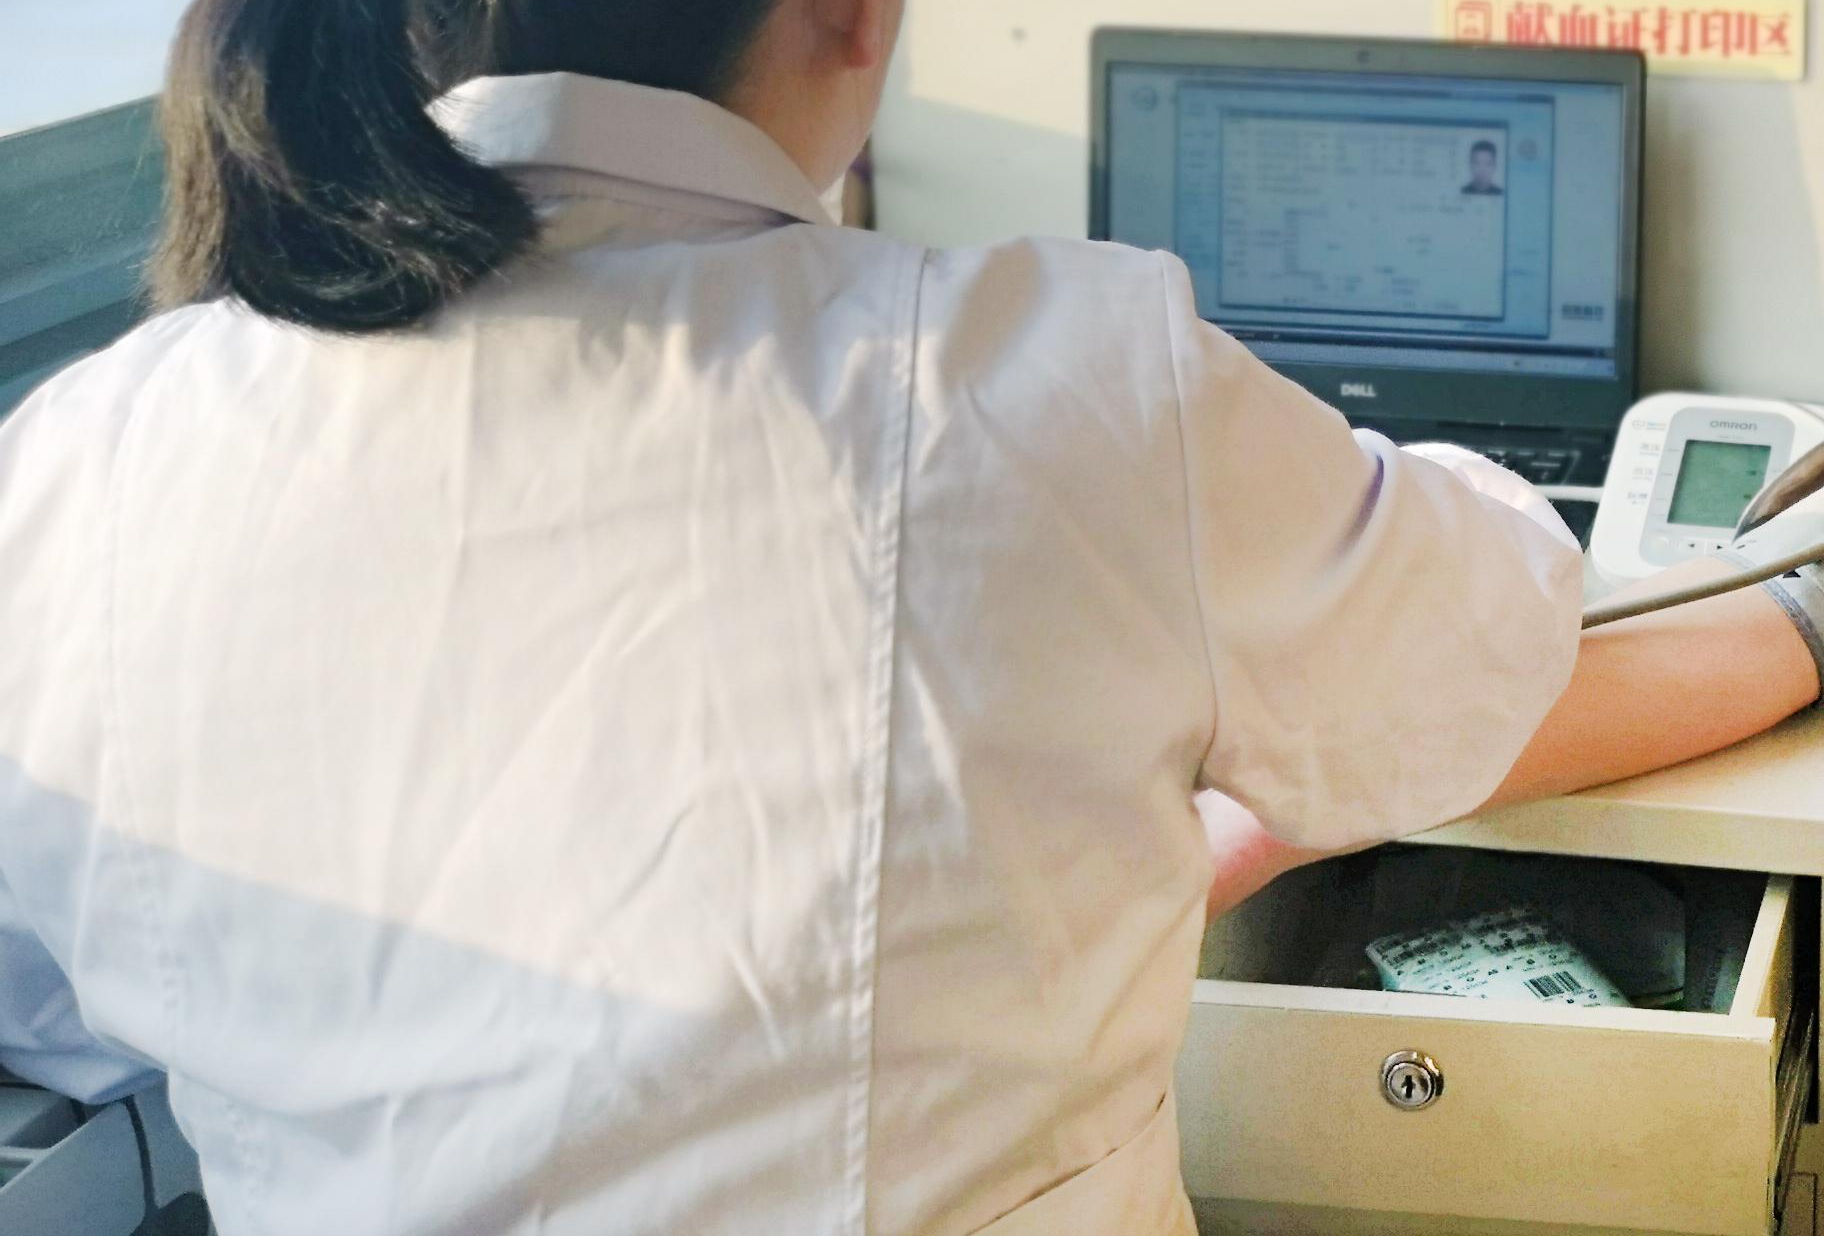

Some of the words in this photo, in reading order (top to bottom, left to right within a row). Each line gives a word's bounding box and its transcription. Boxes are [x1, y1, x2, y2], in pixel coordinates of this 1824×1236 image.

[1505, 0, 1792, 57] 献血证打印区
